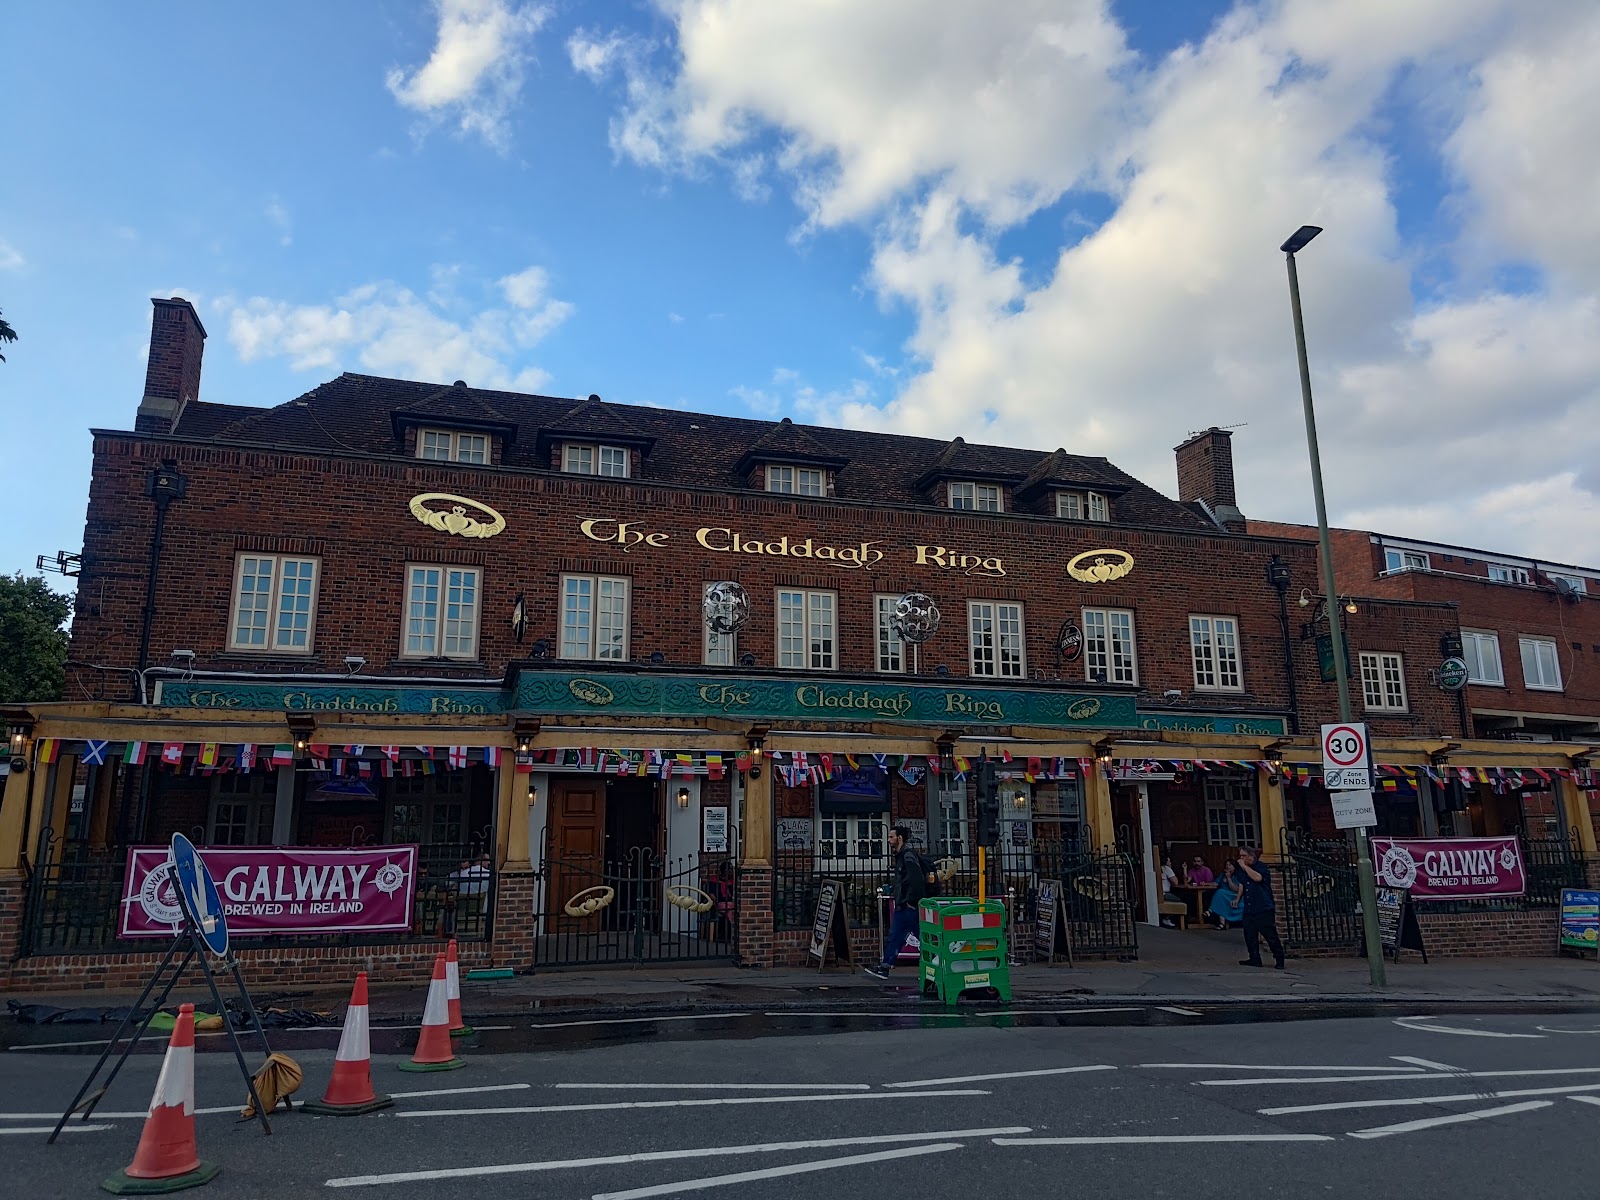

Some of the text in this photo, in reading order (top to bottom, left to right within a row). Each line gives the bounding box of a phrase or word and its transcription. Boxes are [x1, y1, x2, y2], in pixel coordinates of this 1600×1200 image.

[576, 515, 1007, 578] The Claddagh Ring
[188, 690, 241, 707] The
[283, 692, 399, 711] Claddagh
[697, 682, 1005, 720] The Claddagh Ring
[1331, 737, 1358, 754] 30
[1343, 778, 1367, 786] ENDS
[1335, 809, 1353, 817] CCTV
[1355, 807, 1373, 815] ZONE
[1424, 849, 1497, 877] GALWAY
[146, 868, 166, 902] GALWAY
[223, 864, 371, 902] GALWAY
[1427, 875, 1500, 887] BREWED IN IRELAND
[223, 901, 364, 916] BREWED IN IRELAND
